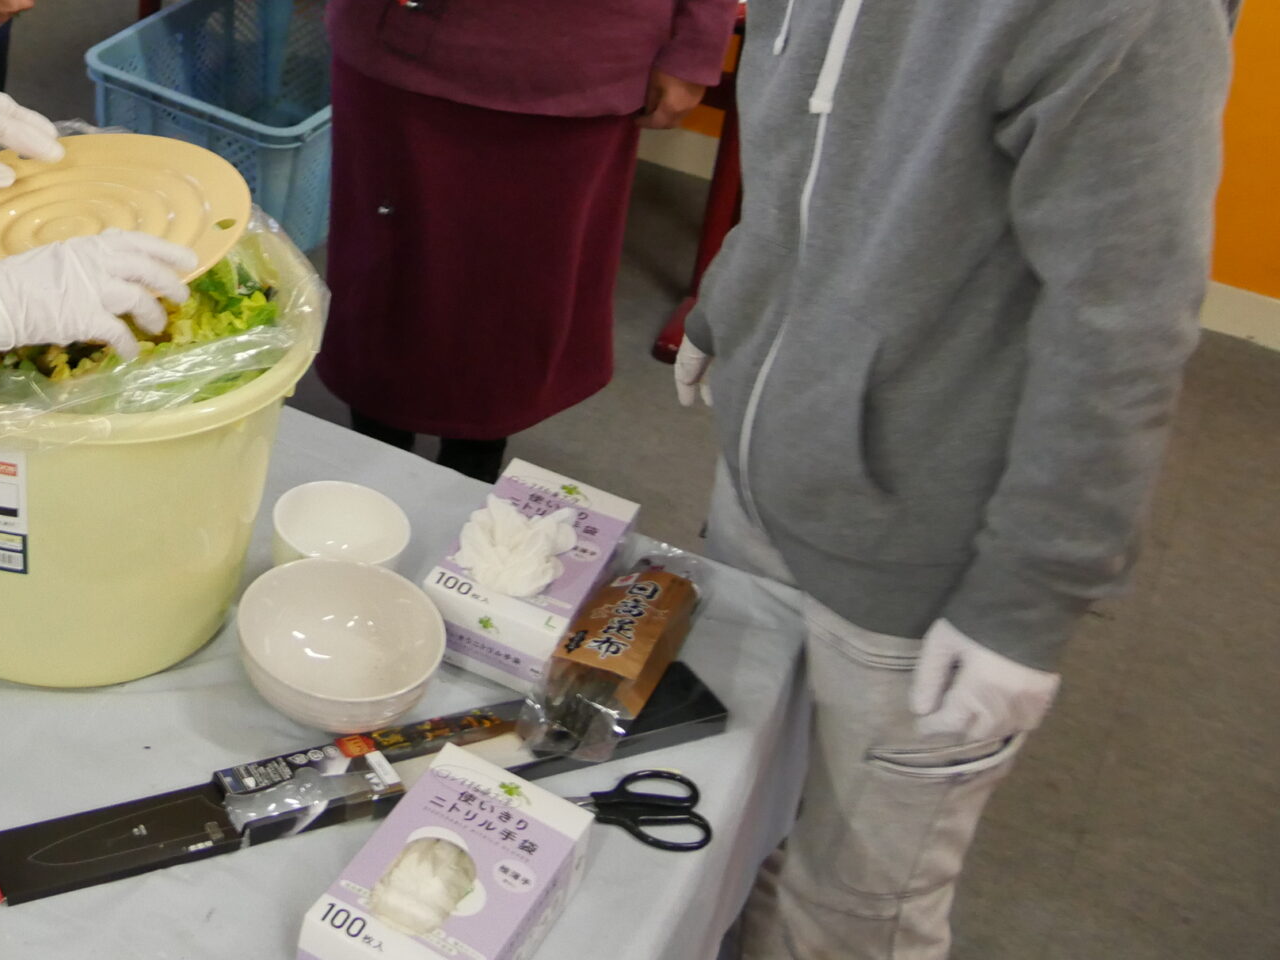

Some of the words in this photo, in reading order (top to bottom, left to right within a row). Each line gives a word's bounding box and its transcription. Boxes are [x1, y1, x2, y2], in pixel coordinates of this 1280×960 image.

[590, 581, 659, 658] 日高昆布
[429, 796, 538, 855] ニトリル手袋
[458, 791, 528, 830] 使いきり
[320, 902, 384, 952] 100枚入
